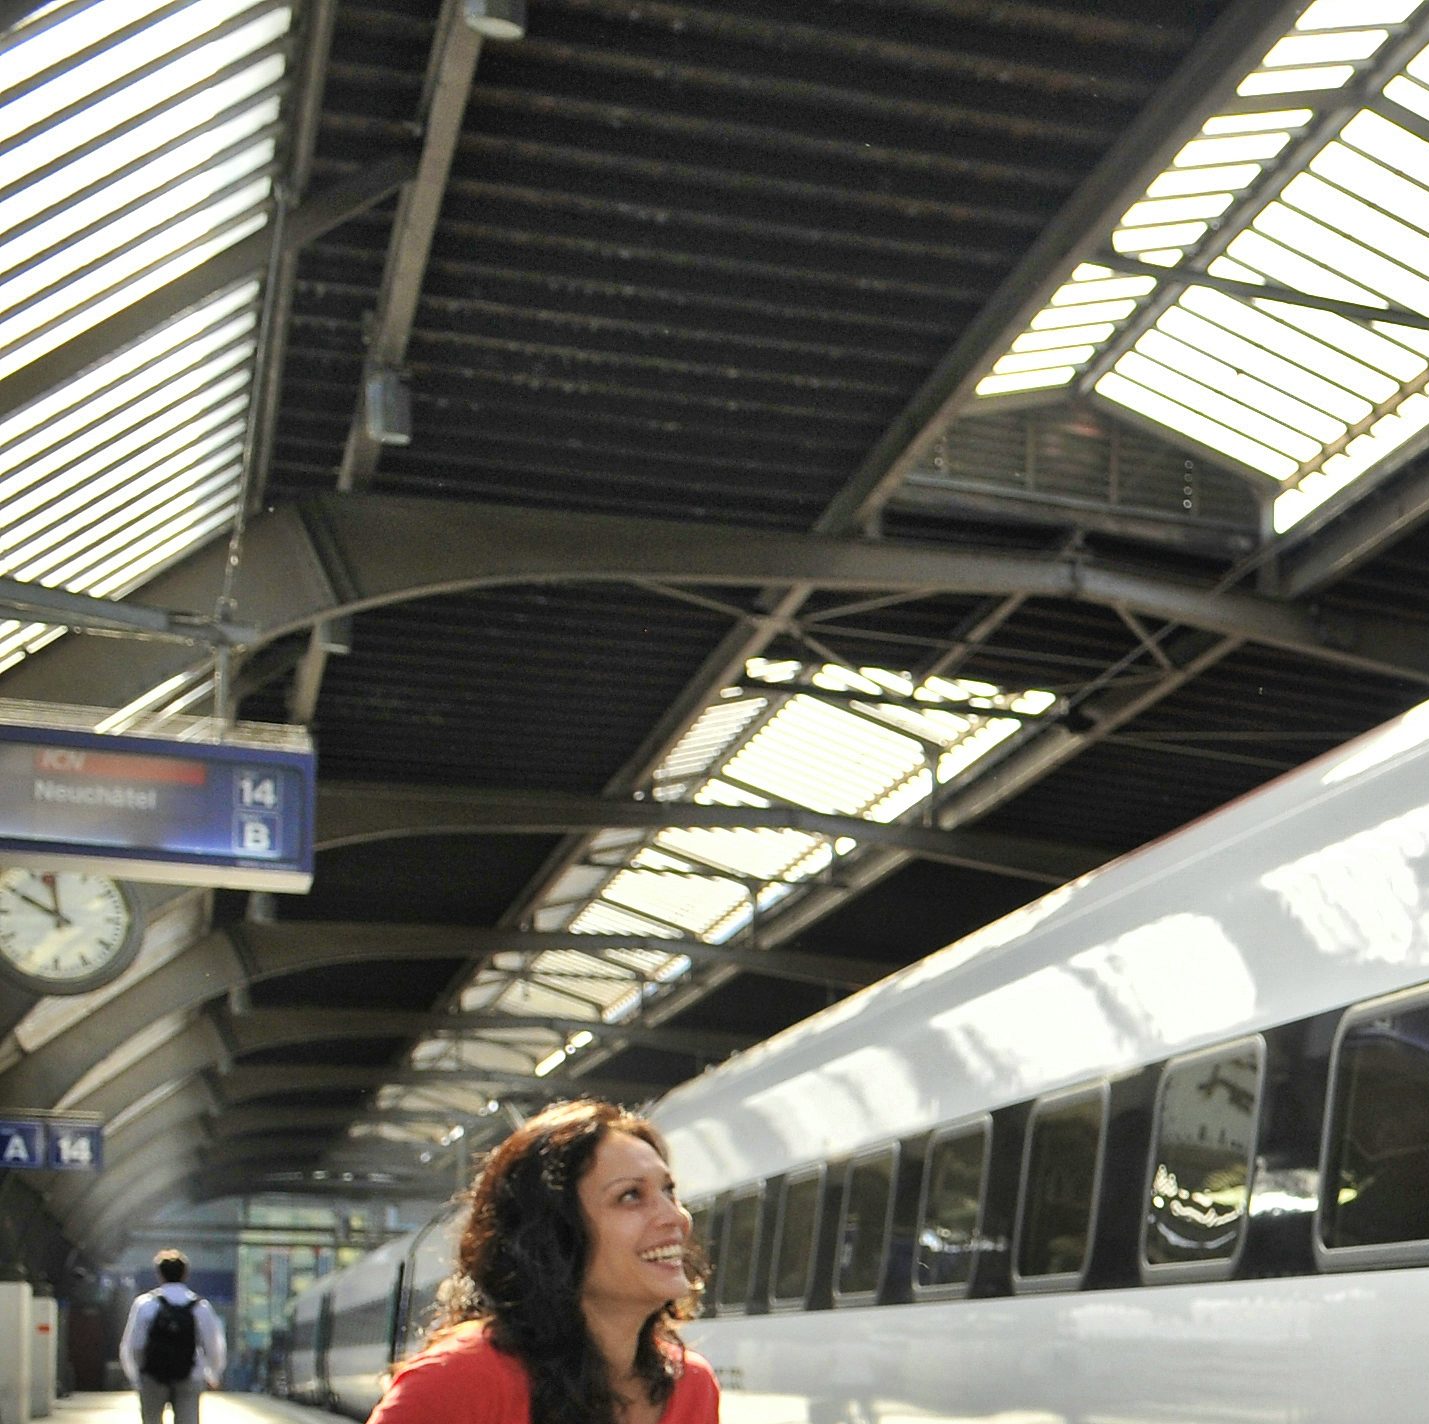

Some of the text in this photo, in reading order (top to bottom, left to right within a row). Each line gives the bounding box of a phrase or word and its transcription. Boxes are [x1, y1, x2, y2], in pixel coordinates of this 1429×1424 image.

[33, 779, 157, 810] Neuchâtel
[240, 777, 276, 809] 14
[243, 821, 271, 850] B
[5, 1134, 29, 1162] A
[58, 1135, 93, 1164] 14
